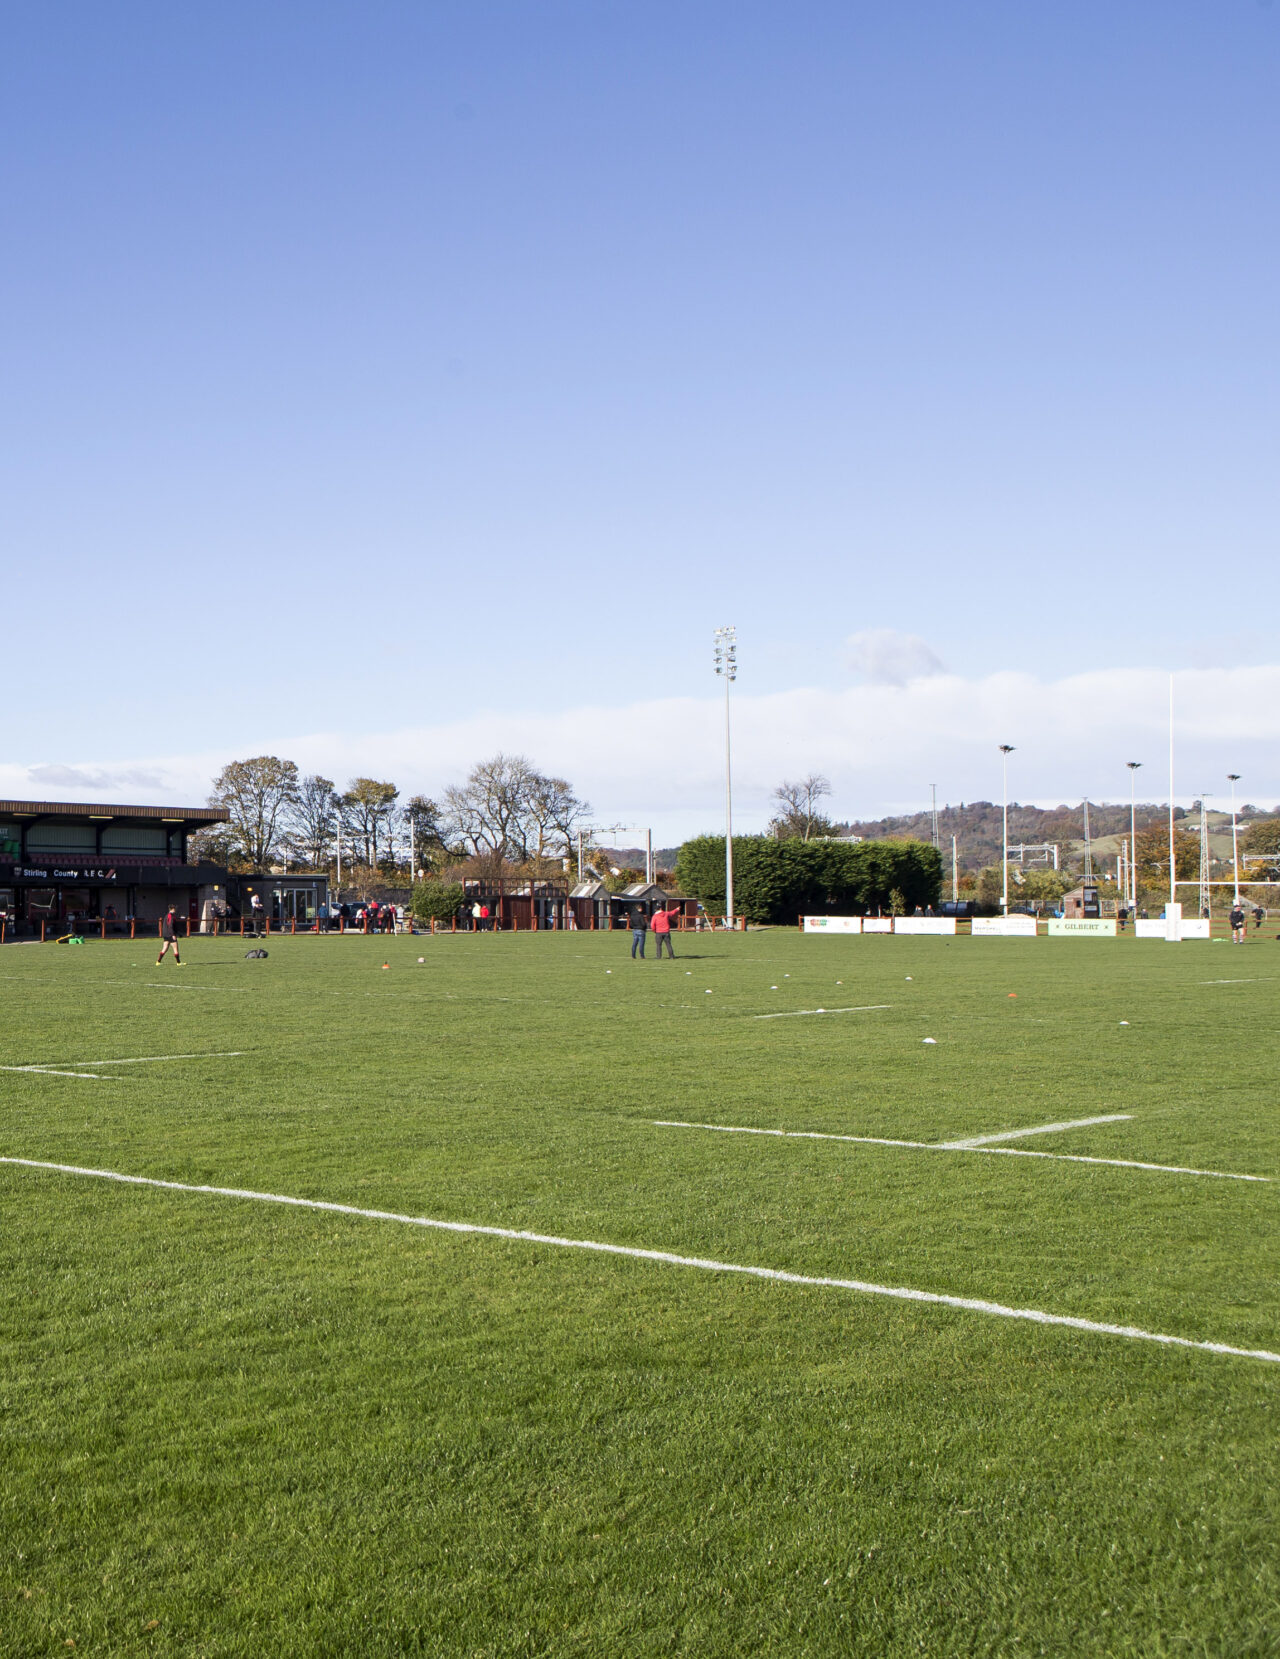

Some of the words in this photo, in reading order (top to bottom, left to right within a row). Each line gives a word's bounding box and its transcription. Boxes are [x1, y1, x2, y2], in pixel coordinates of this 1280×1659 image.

[23, 868, 47, 878] Stirling
[53, 869, 78, 879] County
[1064, 923, 1100, 931] GILBERT
